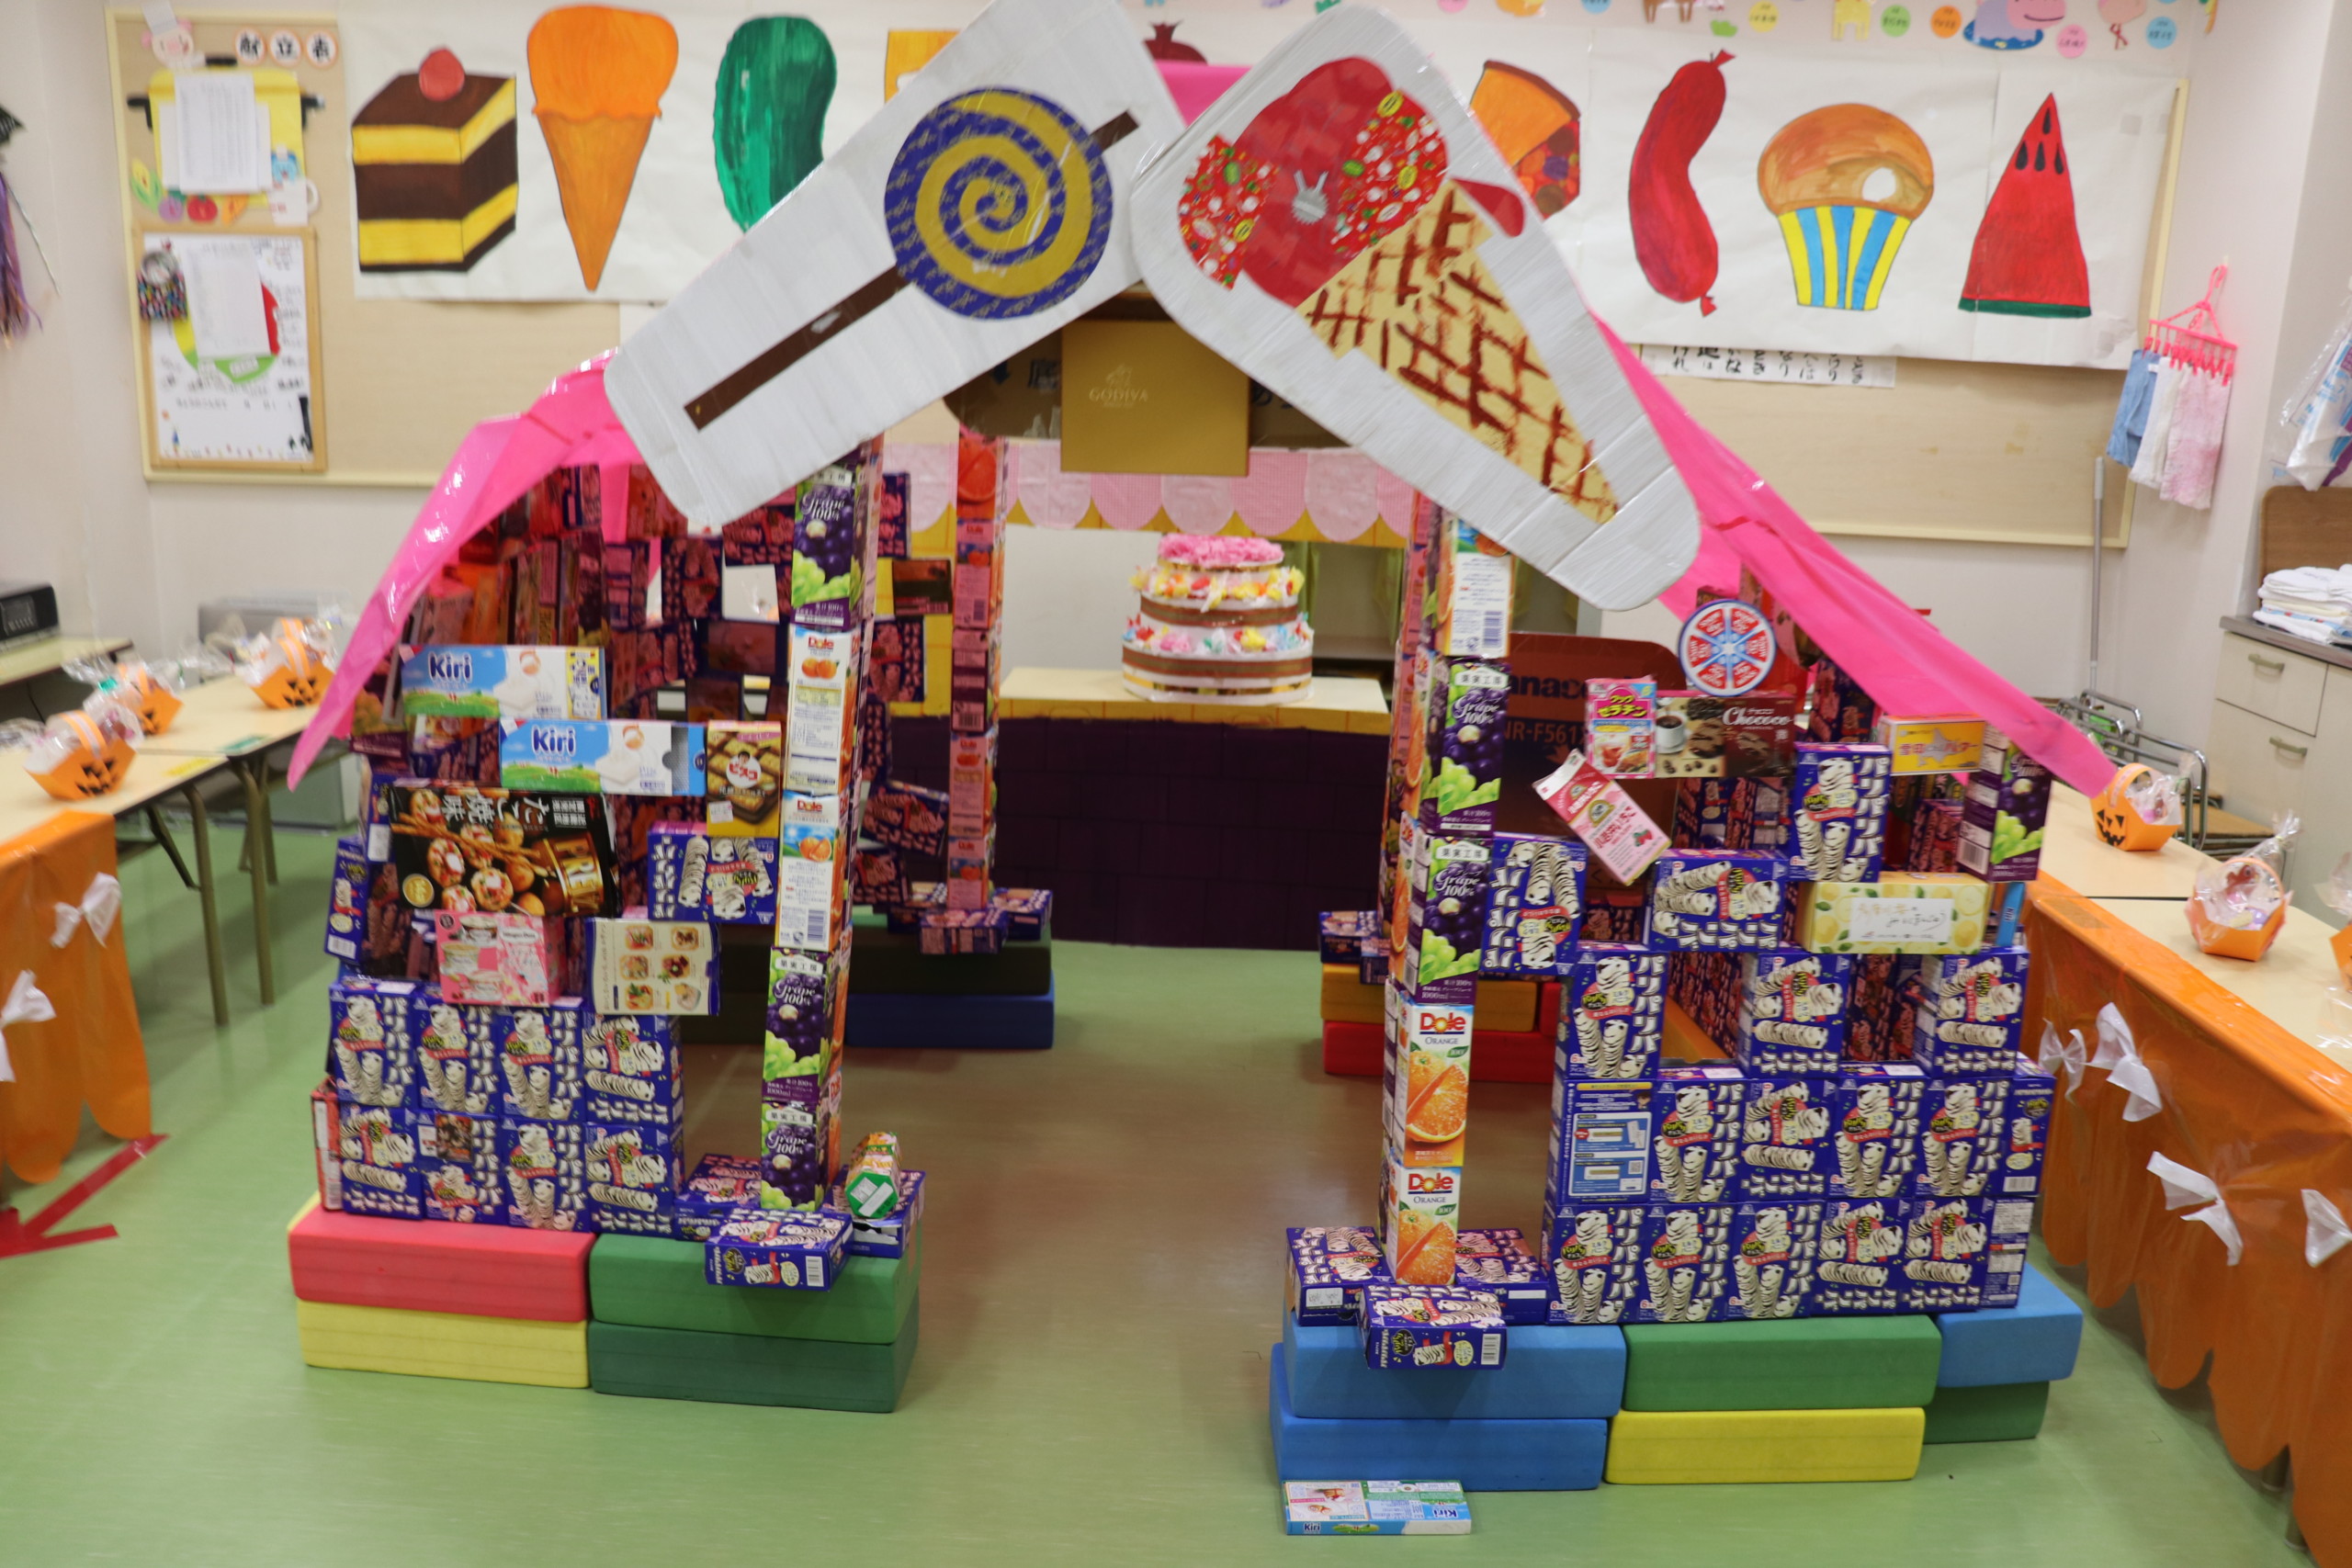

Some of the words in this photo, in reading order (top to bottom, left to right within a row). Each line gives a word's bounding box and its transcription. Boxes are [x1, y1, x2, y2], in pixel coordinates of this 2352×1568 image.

[1089, 388, 1148, 402] GODIVA
[802, 493, 844, 514] Grape
[808, 637, 834, 649] Dole
[429, 651, 472, 682] Kiri
[1453, 695, 1499, 718] Grape
[1598, 705, 1647, 718] ゼラチン
[532, 726, 576, 755] Kiri
[729, 763, 758, 781] ビスコ
[441, 794, 550, 825] たこ焼味
[797, 800, 822, 813] Dole
[1435, 868, 1480, 891] Grape
[775, 981, 815, 998] Grape
[1628, 954, 1668, 1064] パリパリバー
[1419, 1012, 1466, 1033] Dole
[1425, 1036, 1459, 1045] ORANGE
[767, 1130, 807, 1148] Grape
[1408, 1173, 1453, 1192] Dole
[1607, 1208, 1645, 1308] パリパリバー
[1304, 1522, 1320, 1531] Kiri
